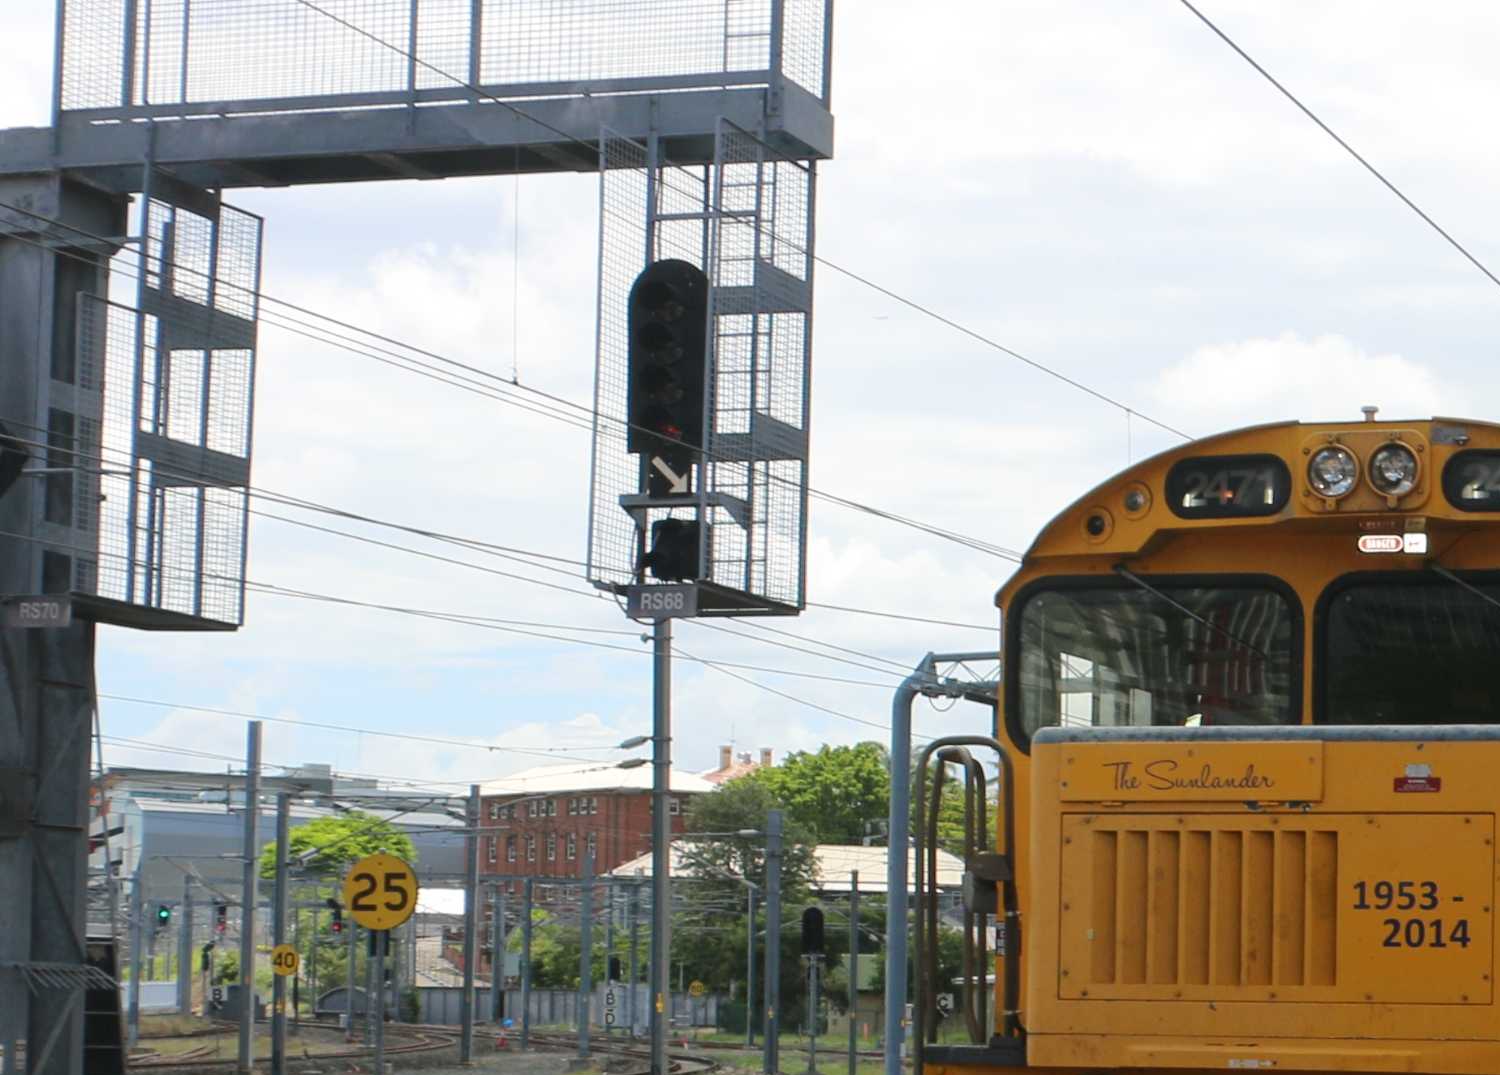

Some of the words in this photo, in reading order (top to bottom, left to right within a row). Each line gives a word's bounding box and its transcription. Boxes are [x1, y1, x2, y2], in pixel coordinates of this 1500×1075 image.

[1183, 467, 1274, 507] 2471
[20, 602, 59, 618] RS70
[641, 592, 684, 609] RS68
[1102, 761, 1141, 790] The
[1144, 759, 1275, 790] Sunlander
[351, 872, 409, 912] 25
[1353, 880, 1439, 910] 1953
[1382, 918, 1471, 948] 2014
[273, 952, 295, 968] 40
